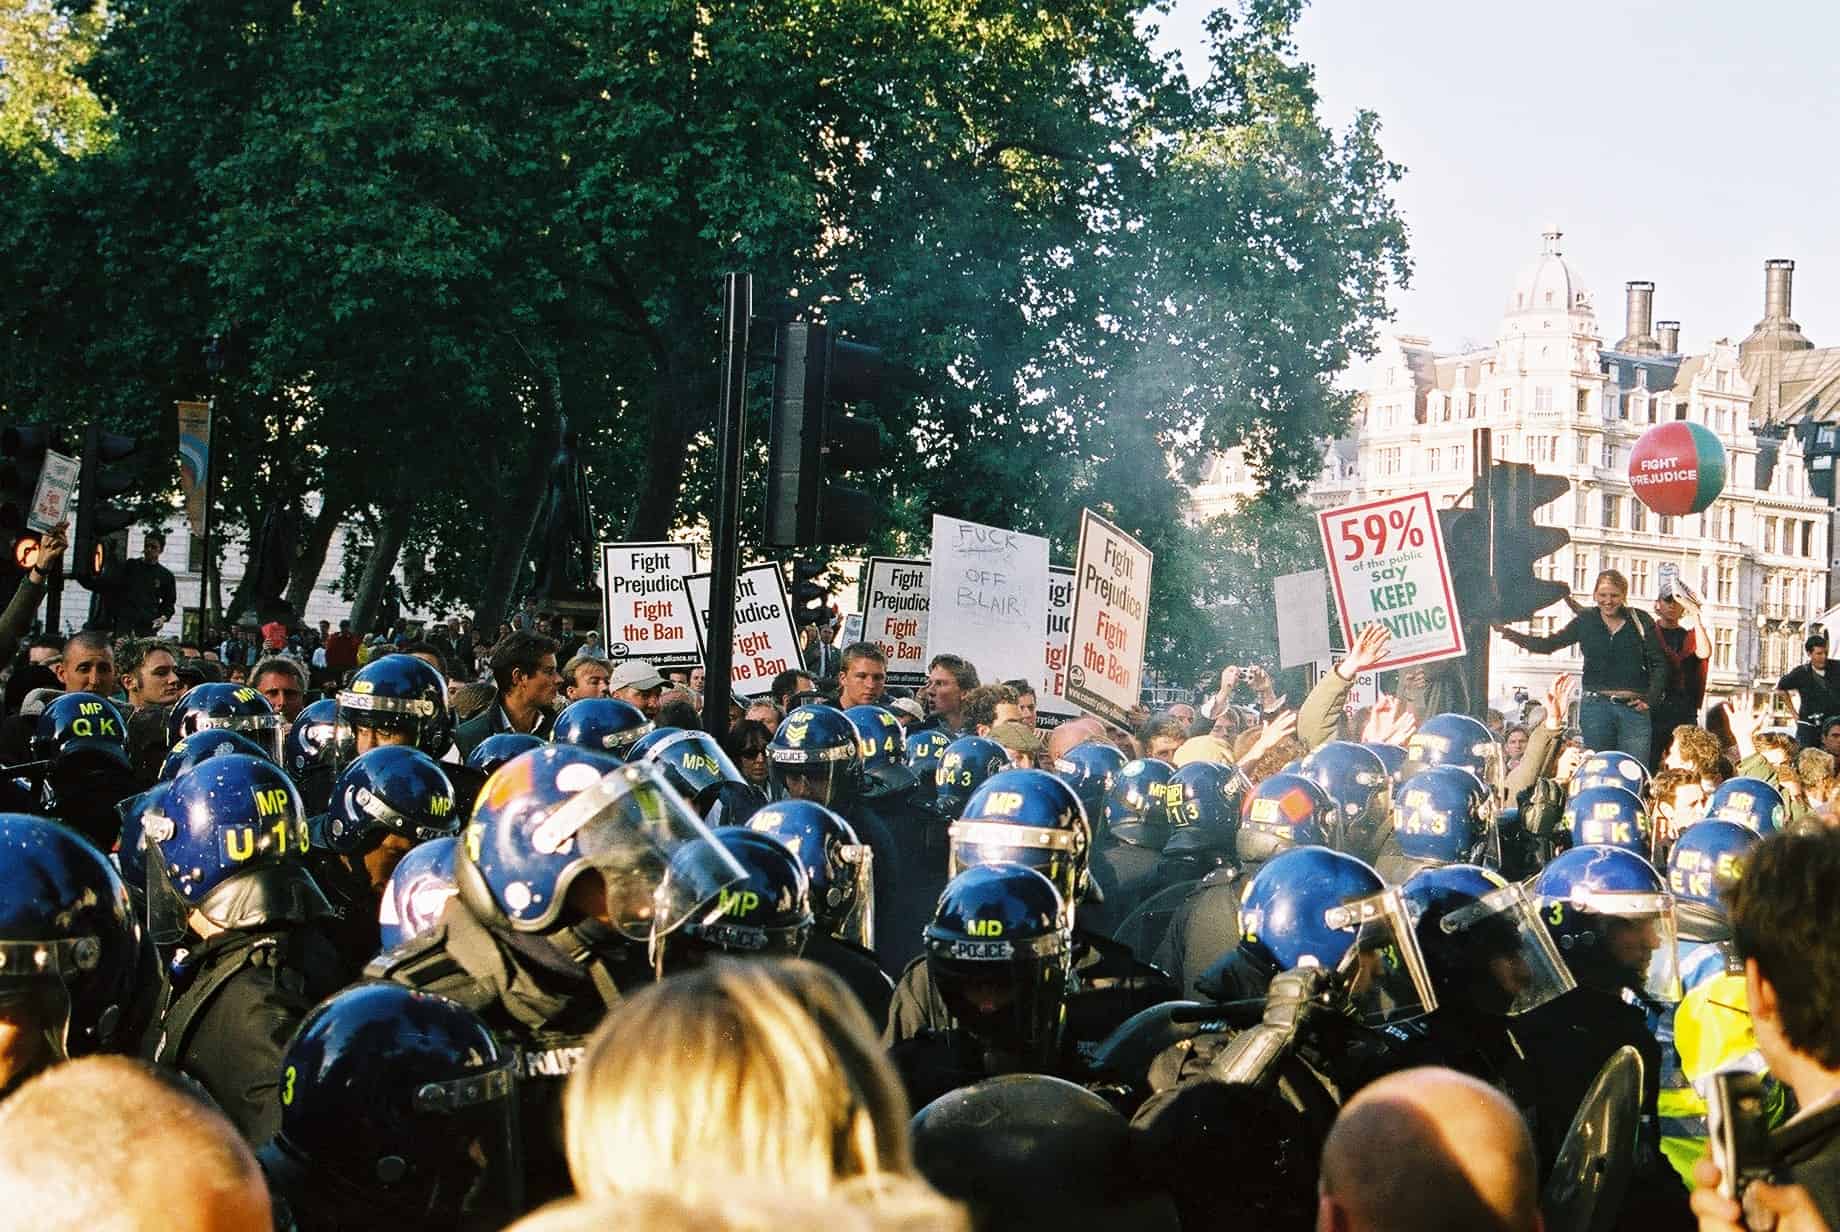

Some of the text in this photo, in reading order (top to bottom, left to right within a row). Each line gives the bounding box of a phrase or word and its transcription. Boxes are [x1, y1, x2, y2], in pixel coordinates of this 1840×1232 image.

[1640, 457, 1679, 472] FIGHT
[1630, 470, 1698, 487] PREJUDICE
[959, 525, 1018, 550] FUCK
[1341, 506, 1424, 562] 59%
[631, 553, 671, 575] Fight
[1104, 538, 1135, 580] Fight
[1367, 559, 1385, 570] the
[1389, 551, 1424, 567] public
[891, 569, 923, 590] Fight
[965, 568, 1007, 587] OFF
[1371, 565, 1408, 583] say
[957, 587, 1022, 616] BLAIR
[1085, 564, 1142, 621] Prejudice
[1370, 582, 1417, 612] KEEP
[634, 600, 673, 623] Fight
[624, 623, 684, 642] the Ban
[885, 617, 917, 640] Fight
[1096, 610, 1128, 652] Fight
[733, 632, 772, 657] ight
[897, 642, 922, 660] Ban
[754, 657, 787, 679] Ban
[1084, 642, 1105, 674] the
[1108, 652, 1130, 689] Ban
[80, 703, 103, 715] MP
[790, 711, 815, 723] MP
[682, 753, 705, 770] MP
[774, 751, 802, 762] POLICE
[256, 789, 288, 817] MP
[431, 796, 453, 817] MP
[719, 886, 759, 918] MP
[1549, 901, 1563, 926] 3
[957, 943, 1007, 959] POLICE
[282, 1066, 297, 1105] 3
